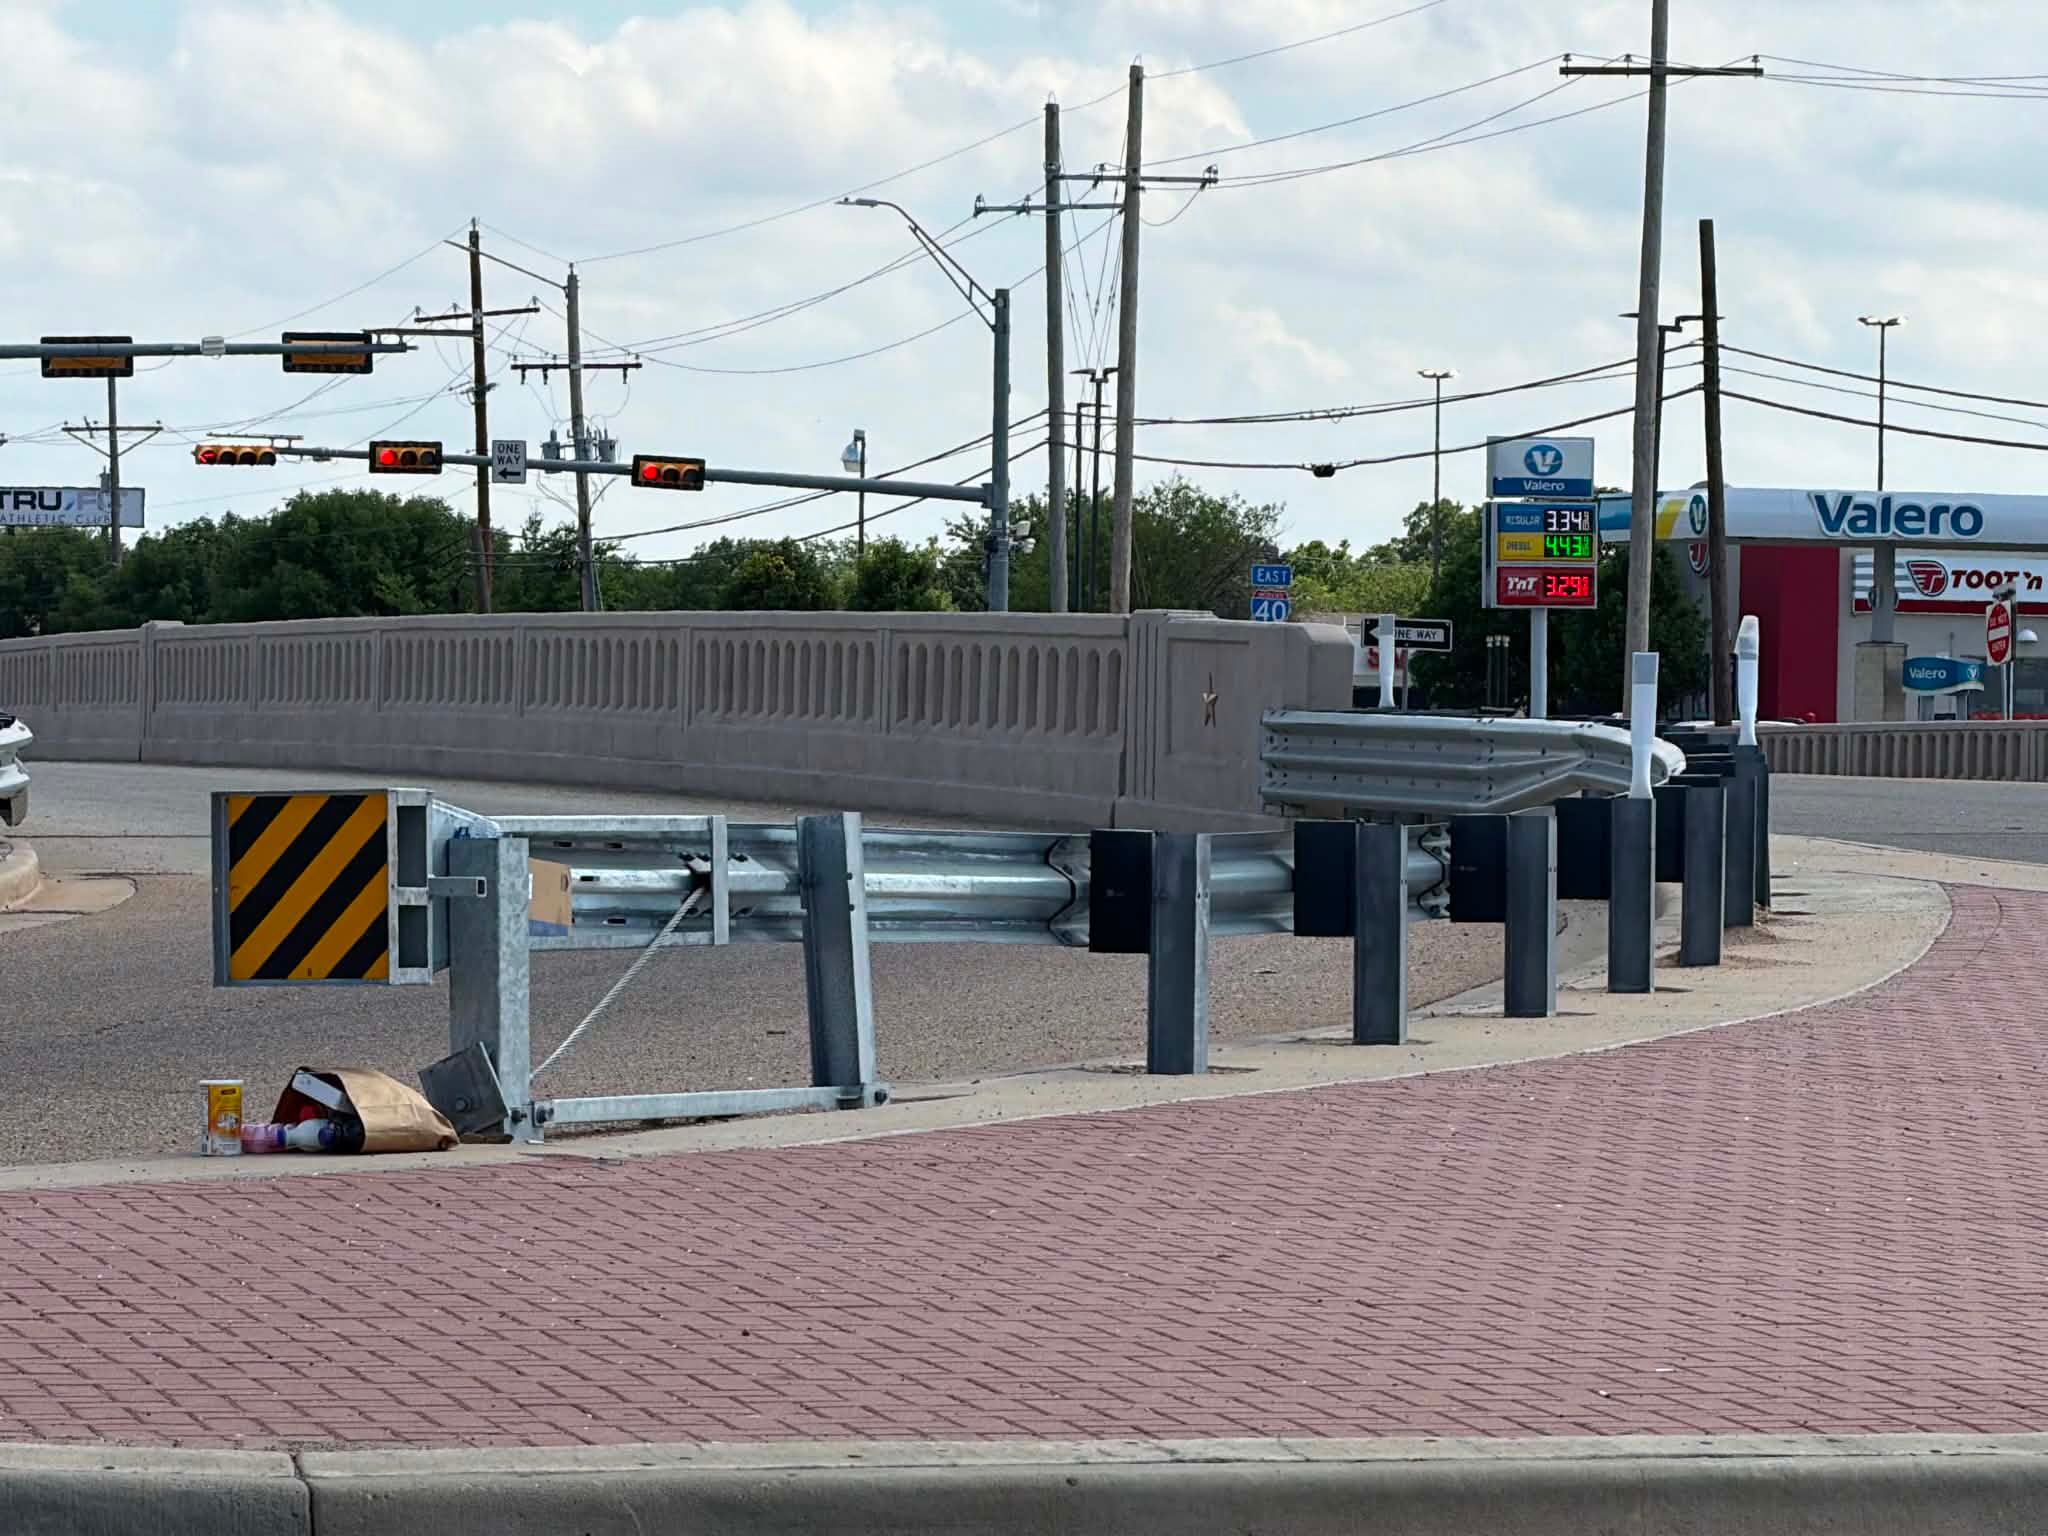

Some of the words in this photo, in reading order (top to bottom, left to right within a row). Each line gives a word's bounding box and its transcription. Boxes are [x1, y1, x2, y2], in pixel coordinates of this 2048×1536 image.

[497, 443, 520, 454] ONE
[497, 455, 521, 465] WAY
[1523, 479, 1565, 491] Valero
[1505, 515, 1541, 526] REGULAR
[1814, 494, 1984, 537] Valero
[1257, 567, 1288, 583] EAST
[1255, 599, 1286, 622] 40
[1416, 629, 1438, 641] WAY
[1909, 667, 1947, 680] Valero
